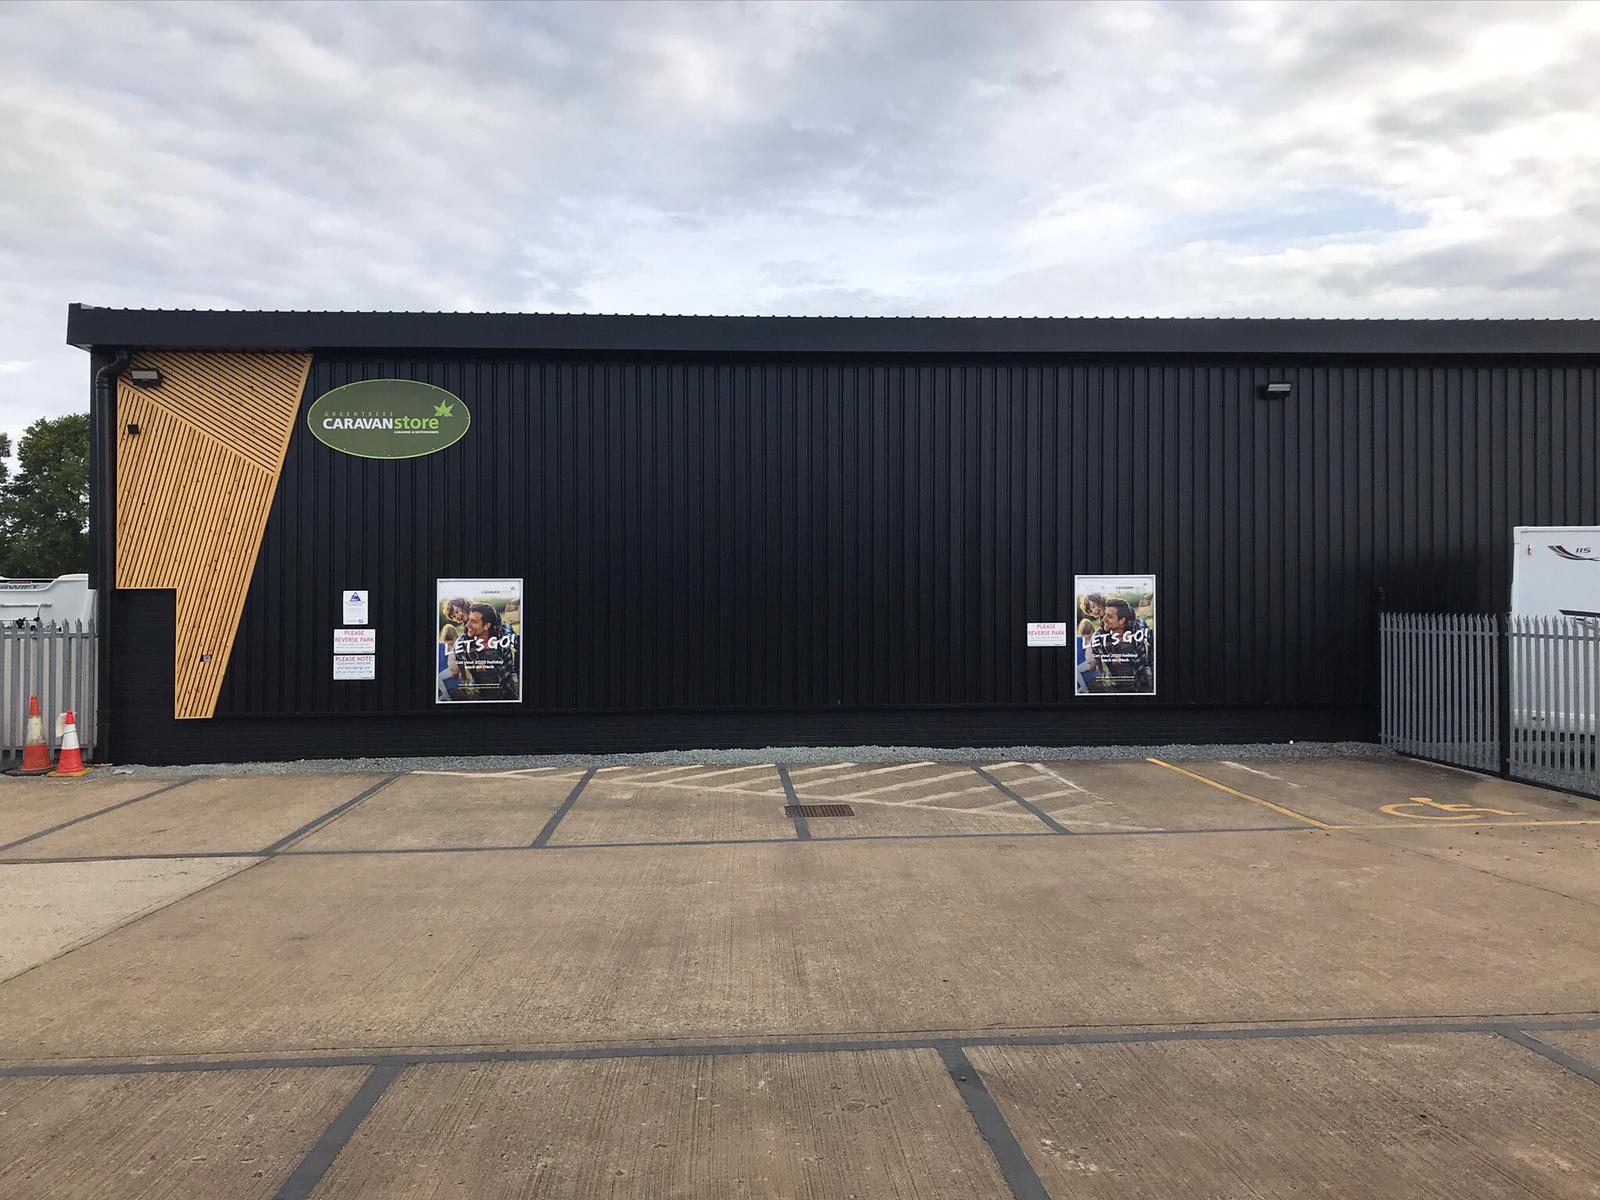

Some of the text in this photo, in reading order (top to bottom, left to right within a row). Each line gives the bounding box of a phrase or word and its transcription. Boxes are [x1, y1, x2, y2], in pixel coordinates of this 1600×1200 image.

[444, 633, 515, 656] LET'S GO!
[1082, 627, 1149, 650] LET'S GO!
